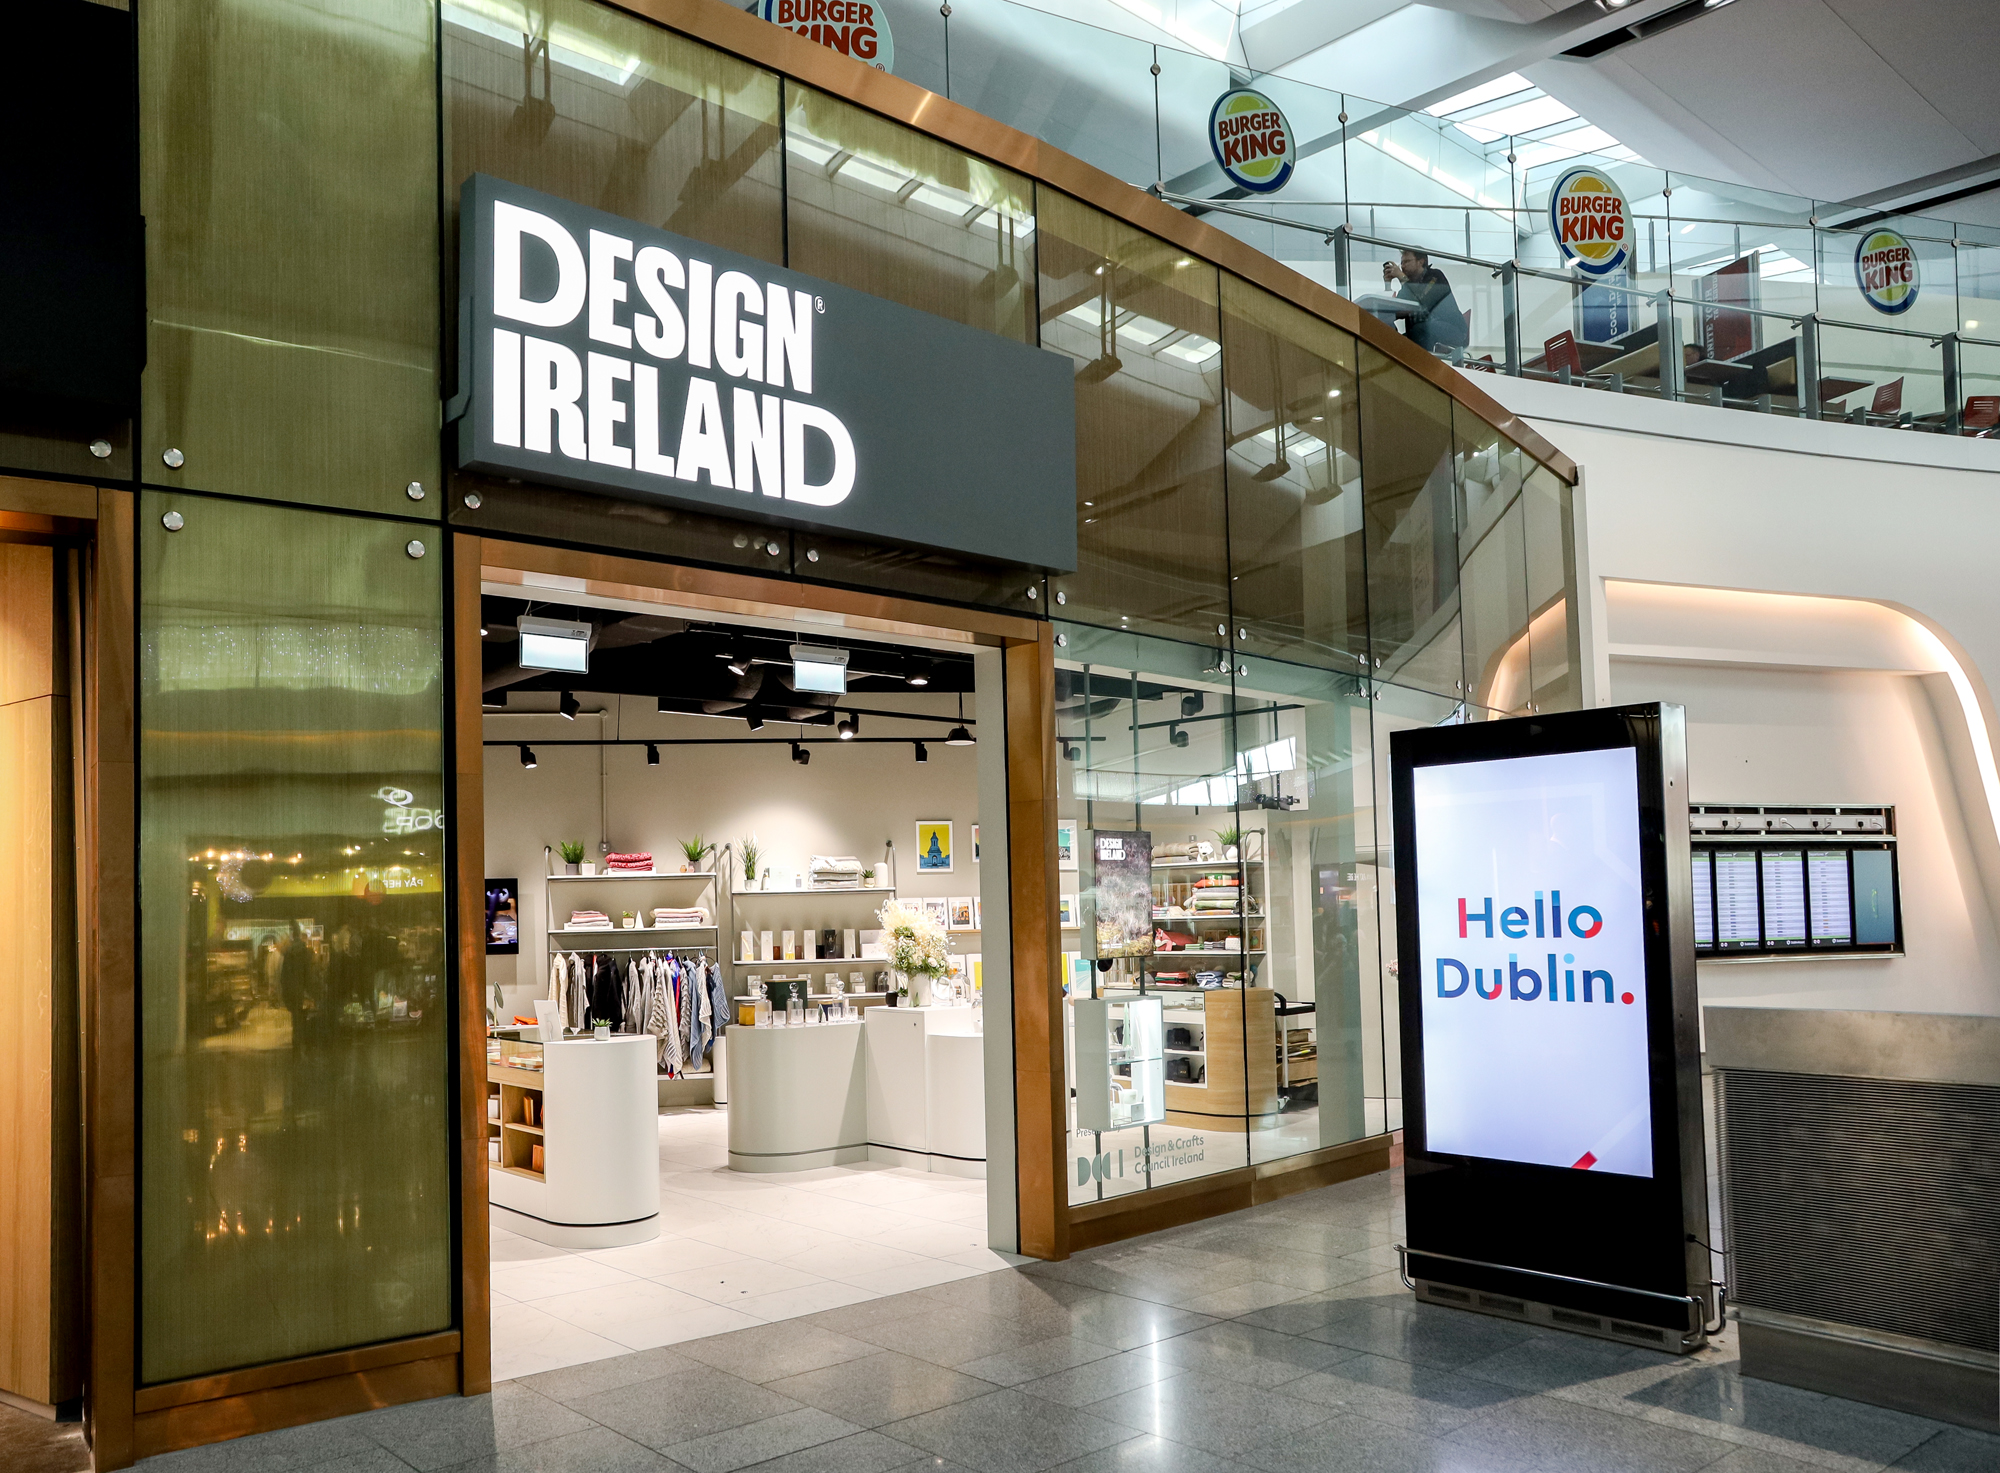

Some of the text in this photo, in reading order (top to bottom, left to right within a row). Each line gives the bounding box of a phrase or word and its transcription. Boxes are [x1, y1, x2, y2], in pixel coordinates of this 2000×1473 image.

[778, 0, 874, 26] BURGER
[1218, 112, 1281, 140] BURGER
[1223, 130, 1286, 167] KING
[1560, 196, 1622, 216] BURGER
[1562, 215, 1624, 243] KING
[1862, 247, 1910, 272] BURGER
[1865, 261, 1913, 293] KING
[493, 199, 812, 394] DESIGN
[1609, 303, 1618, 336] COOL
[1706, 323, 1714, 359] GNITE
[493, 327, 857, 507] IRELAND
[1458, 890, 1603, 939] Hello
[1436, 953, 1635, 1005] Dublin.
[1134, 1135, 1204, 1158] Design & Crafts
[1134, 1149, 1204, 1174] Council Ireland
